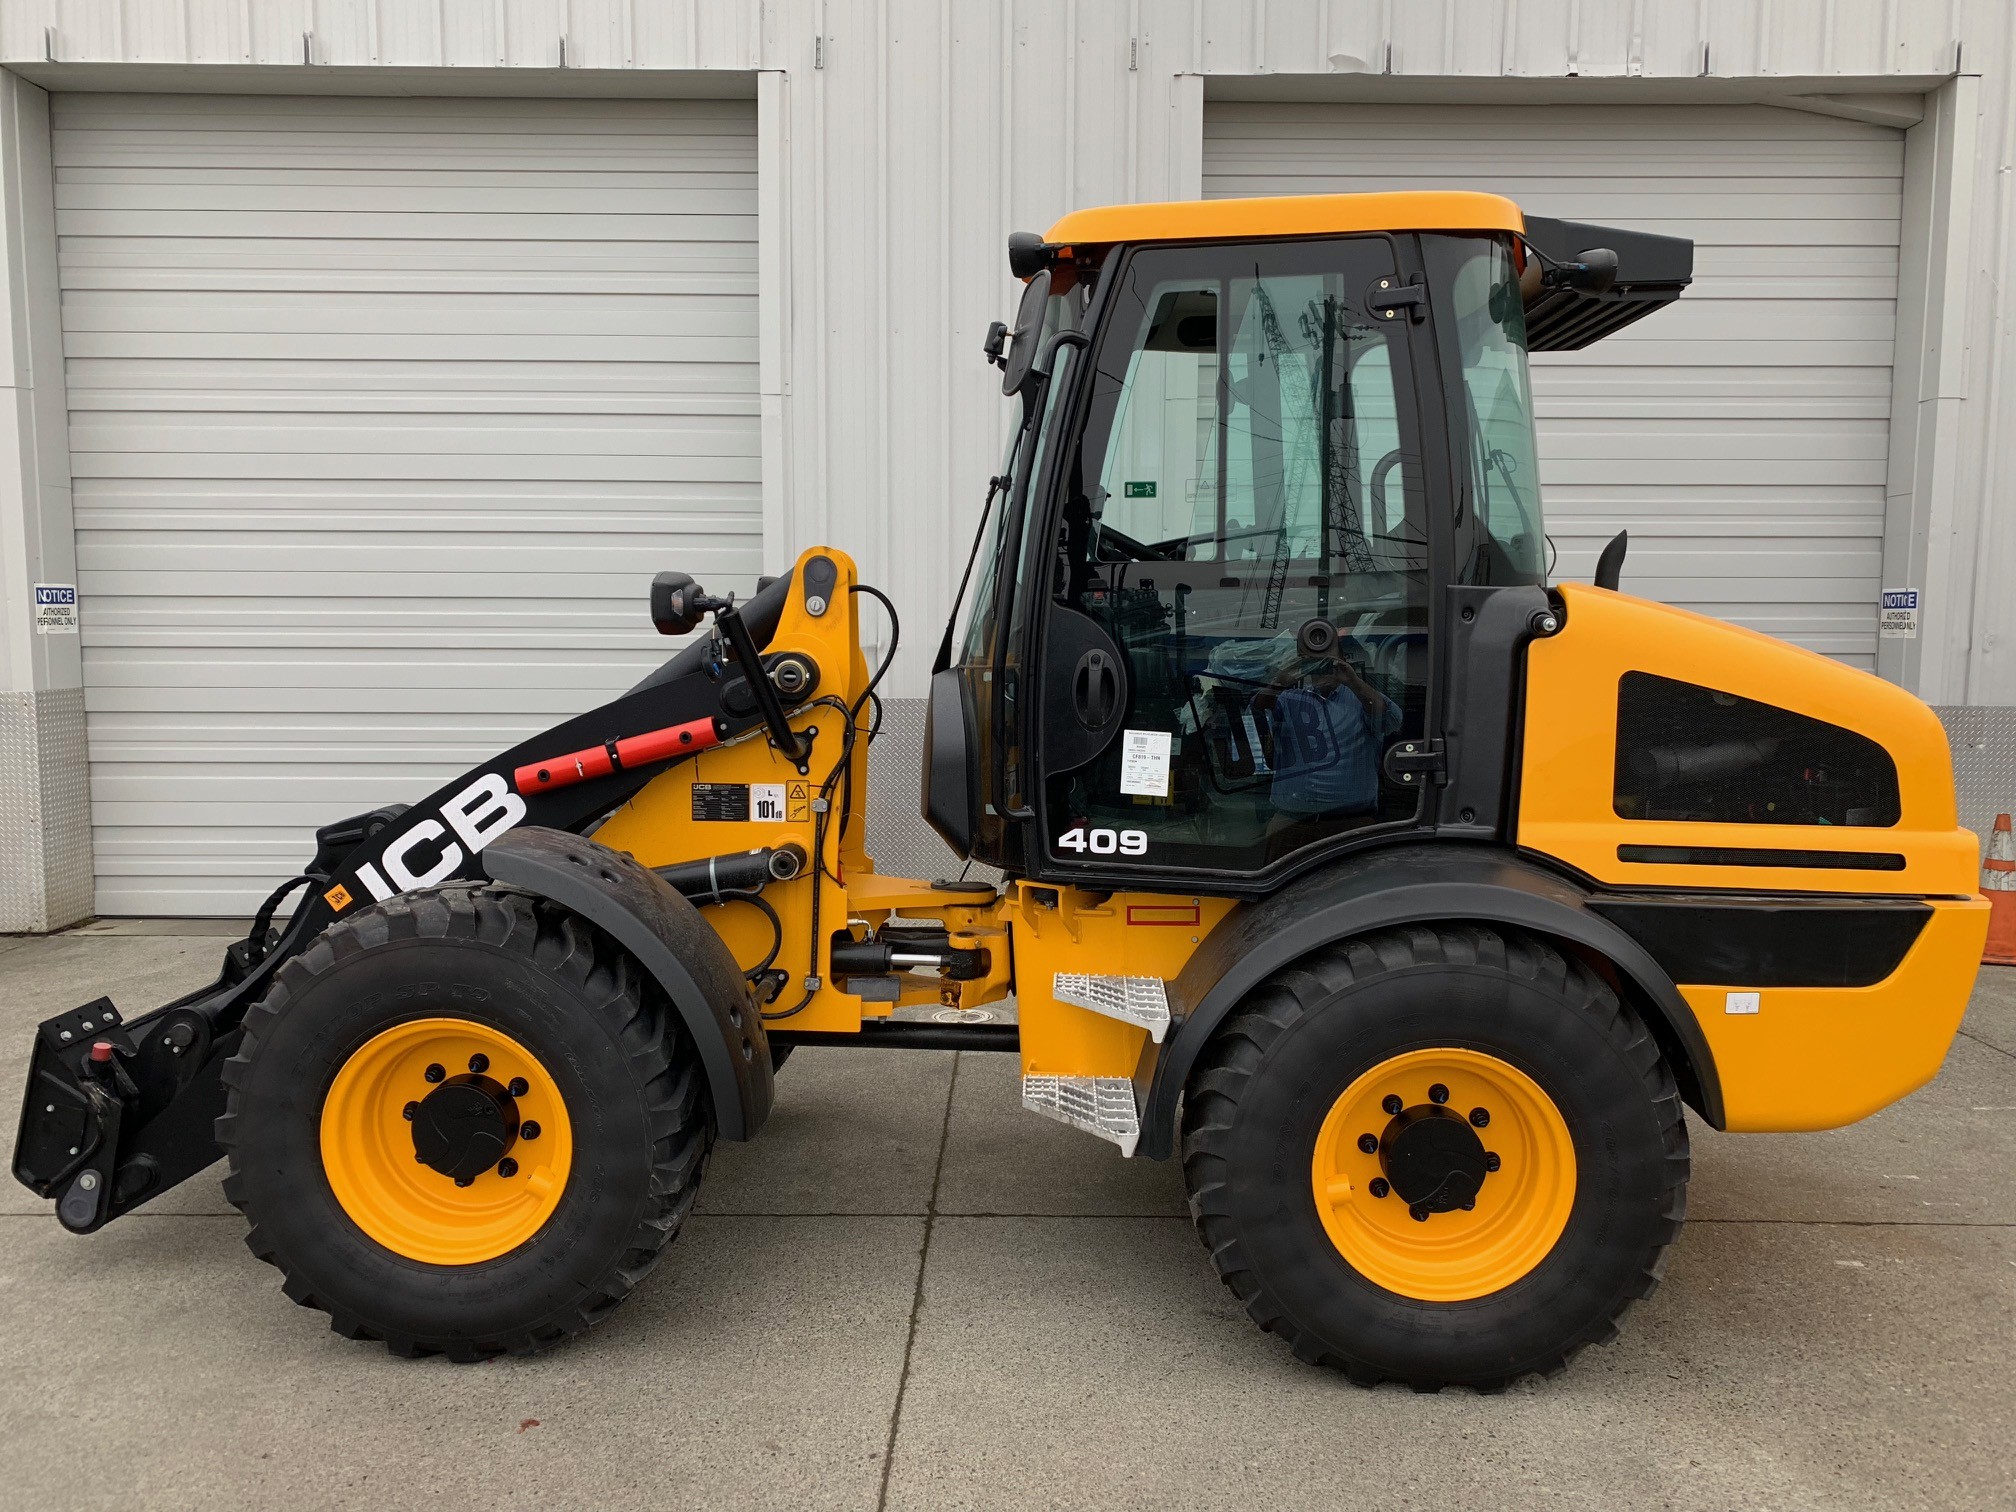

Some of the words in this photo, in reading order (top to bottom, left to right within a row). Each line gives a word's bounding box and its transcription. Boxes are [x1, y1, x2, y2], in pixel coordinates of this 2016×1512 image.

[37, 589, 73, 602] NOTICE
[37, 617, 63, 625] PERONNEL
[64, 617, 76, 625] ONLY
[1887, 612, 1910, 620] AUTHORIZD
[757, 800, 775, 818] 101
[775, 810, 782, 818] dB
[1058, 828, 1148, 856] 409
